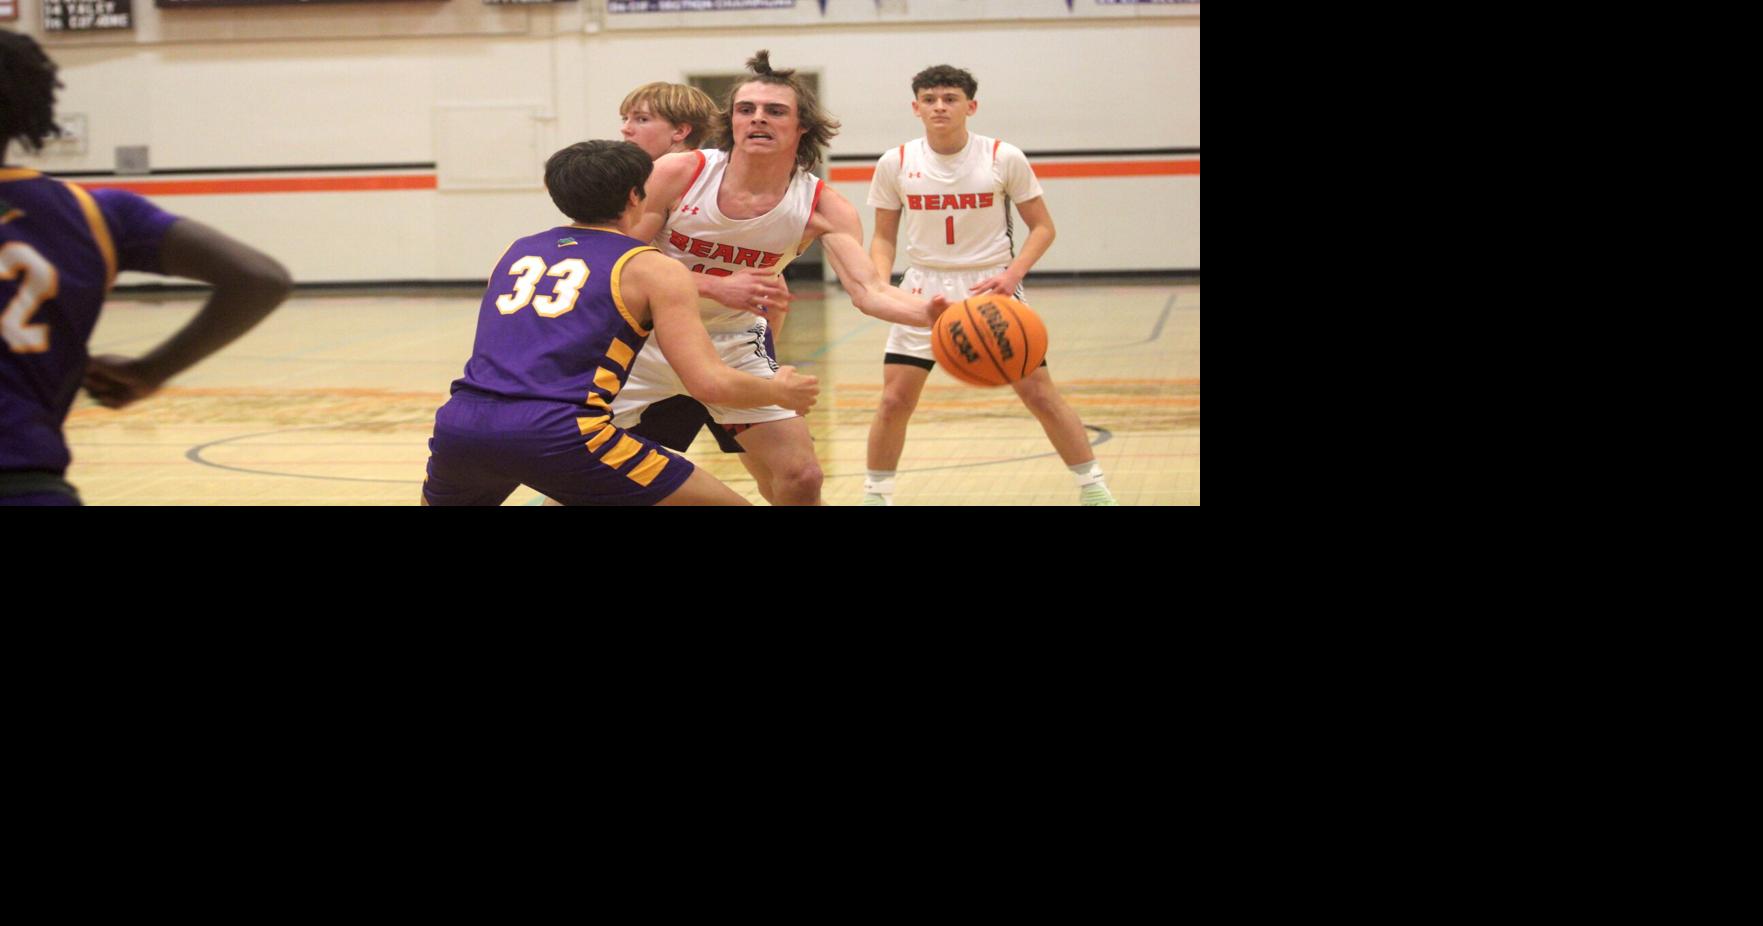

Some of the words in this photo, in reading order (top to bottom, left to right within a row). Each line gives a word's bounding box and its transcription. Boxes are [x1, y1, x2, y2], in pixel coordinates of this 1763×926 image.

[906, 192, 994, 210] BEARS
[668, 229, 784, 268] BEARS
[945, 215, 955, 245] 1
[494, 256, 591, 318] 33
[949, 320, 980, 364] NCAA
[976, 302, 1014, 362] Wilson
